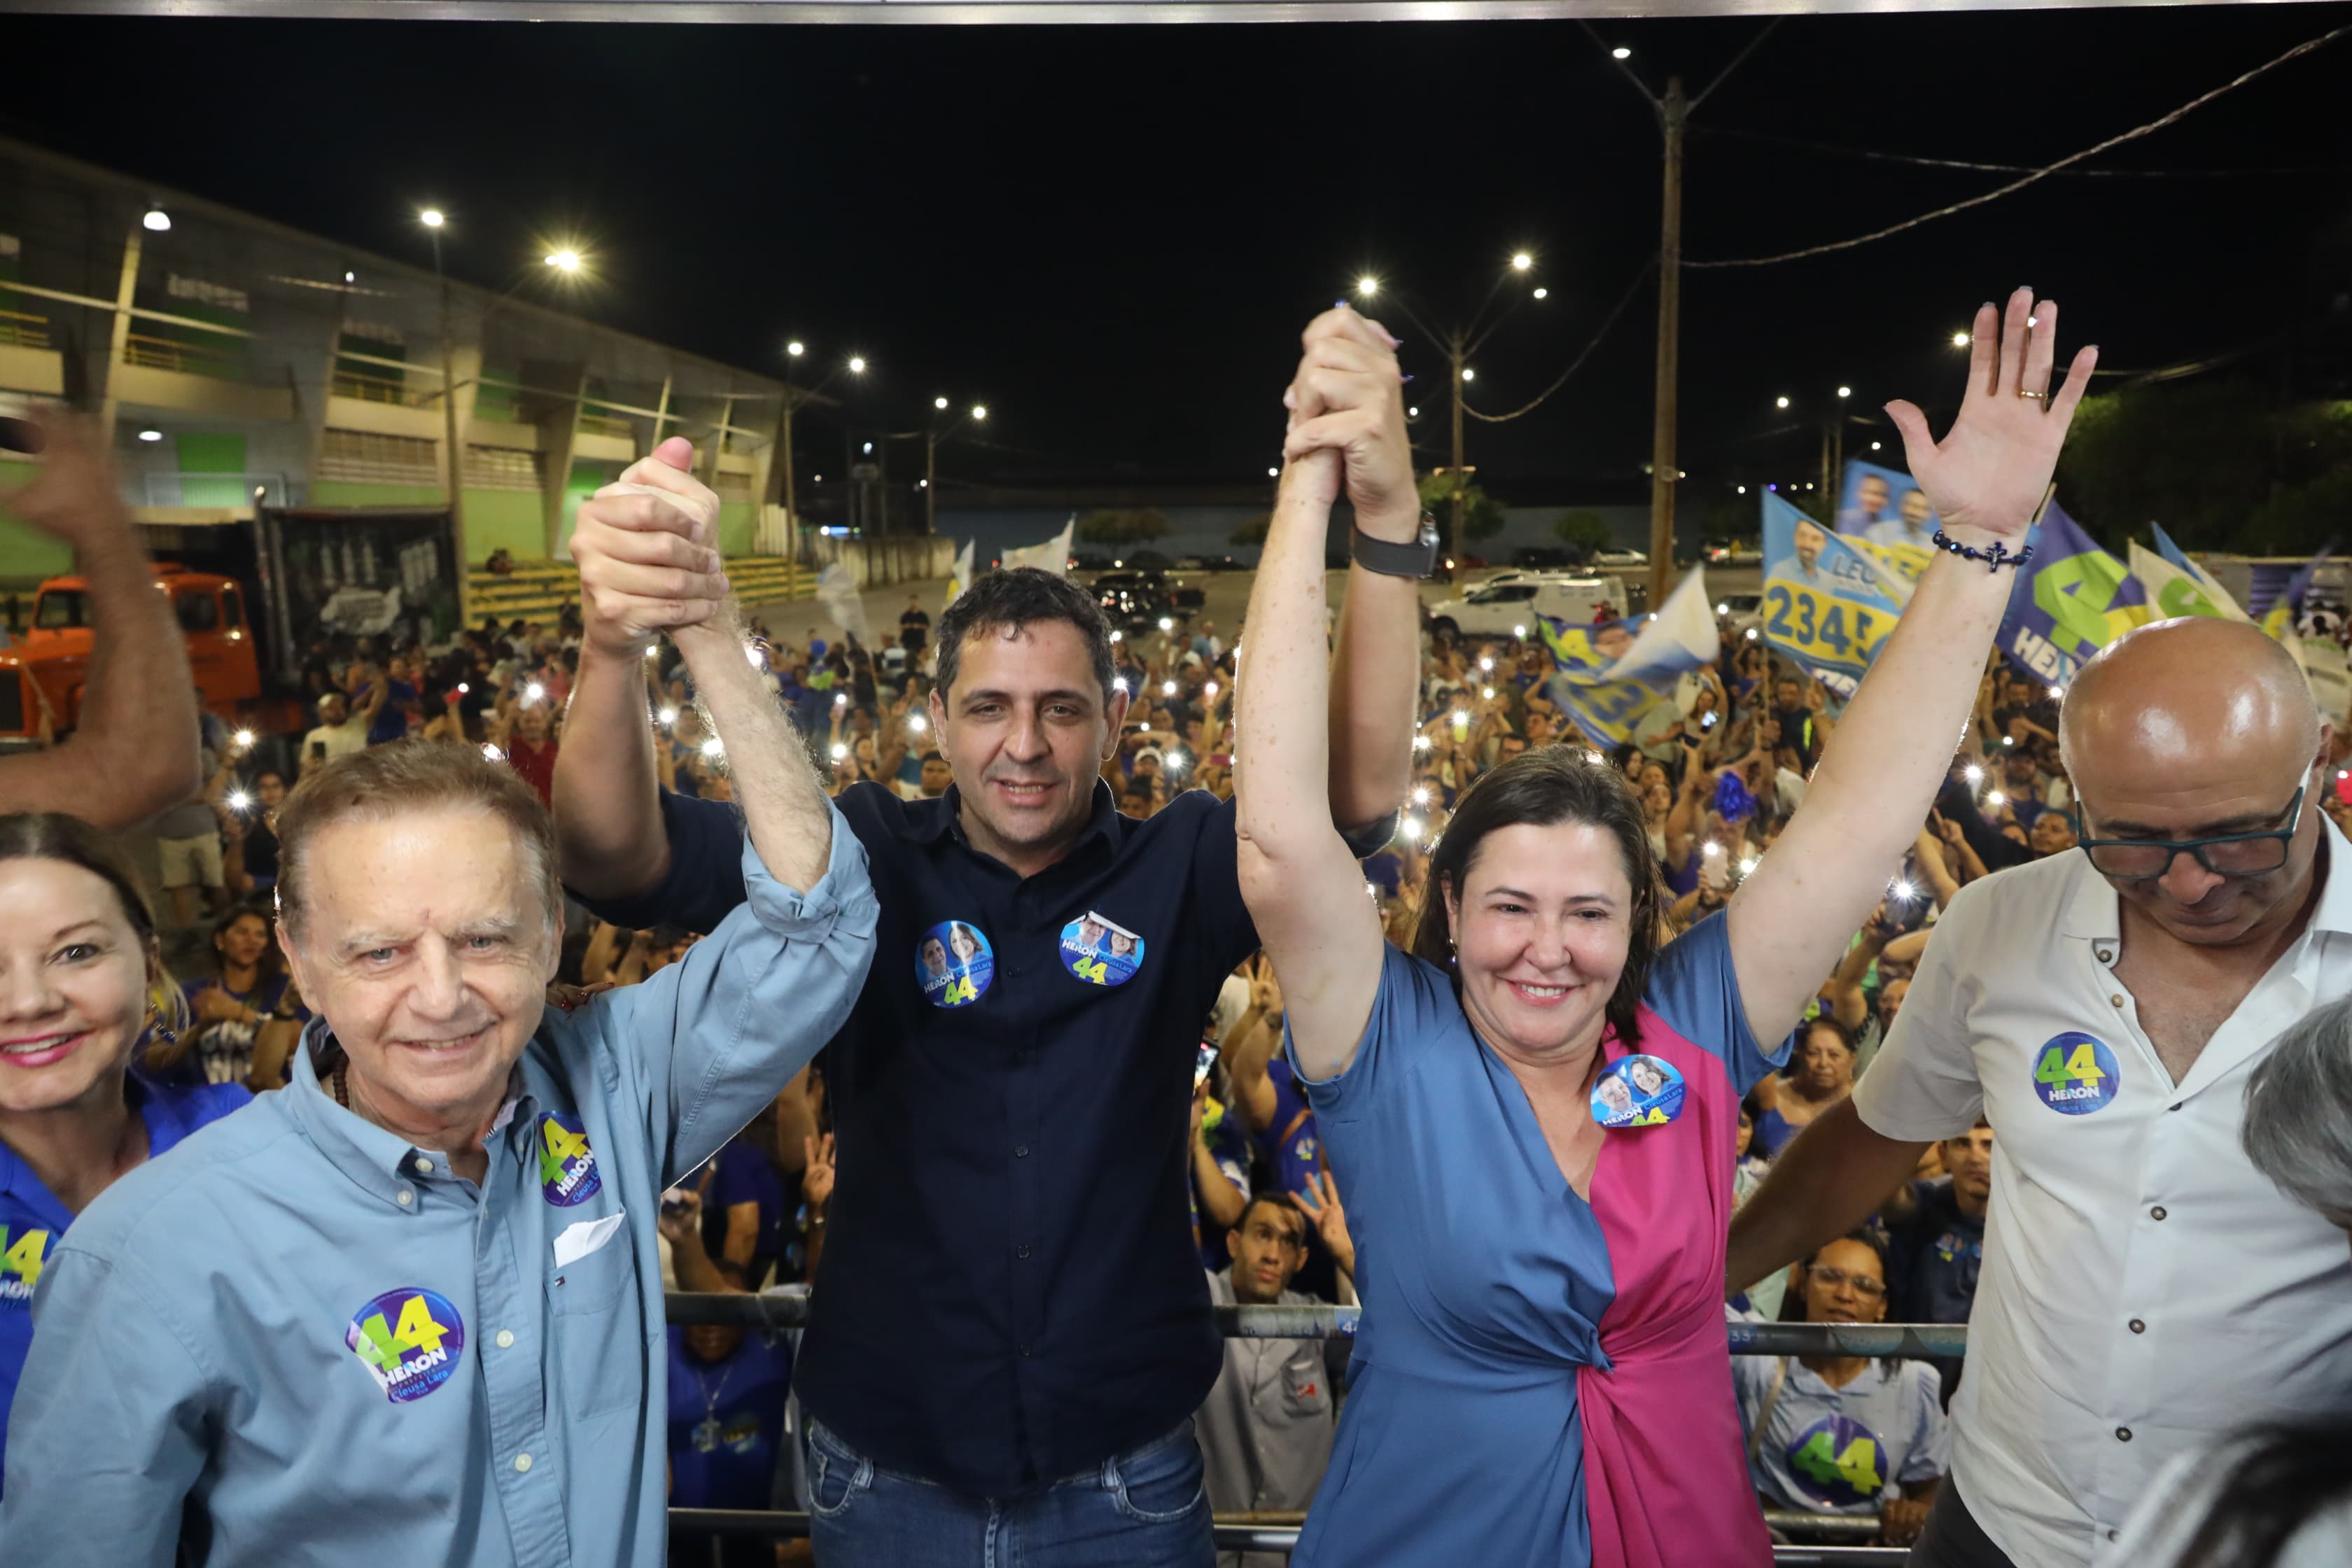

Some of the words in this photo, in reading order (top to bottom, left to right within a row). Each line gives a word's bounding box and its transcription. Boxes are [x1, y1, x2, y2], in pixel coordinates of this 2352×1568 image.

[1062, 939, 1098, 959] HERON
[977, 961, 992, 971] Lara
[1072, 956, 1108, 984] 44
[1119, 960, 1133, 973] Lara
[923, 972, 955, 994] HERON
[944, 975, 979, 1006] 44
[2036, 1043, 2106, 1091] 44
[1667, 1087, 1684, 1102] Lara
[2048, 1086, 2101, 1102] HERON
[1602, 1106, 1644, 1126] HERON
[556, 1149, 595, 1197] HERON
[572, 1180, 594, 1203] Cleusa
[356, 1294, 449, 1372] 44
[382, 1346, 447, 1386] HERON
[426, 1370, 449, 1385] Lara
[1791, 1431, 1882, 1495] 44
